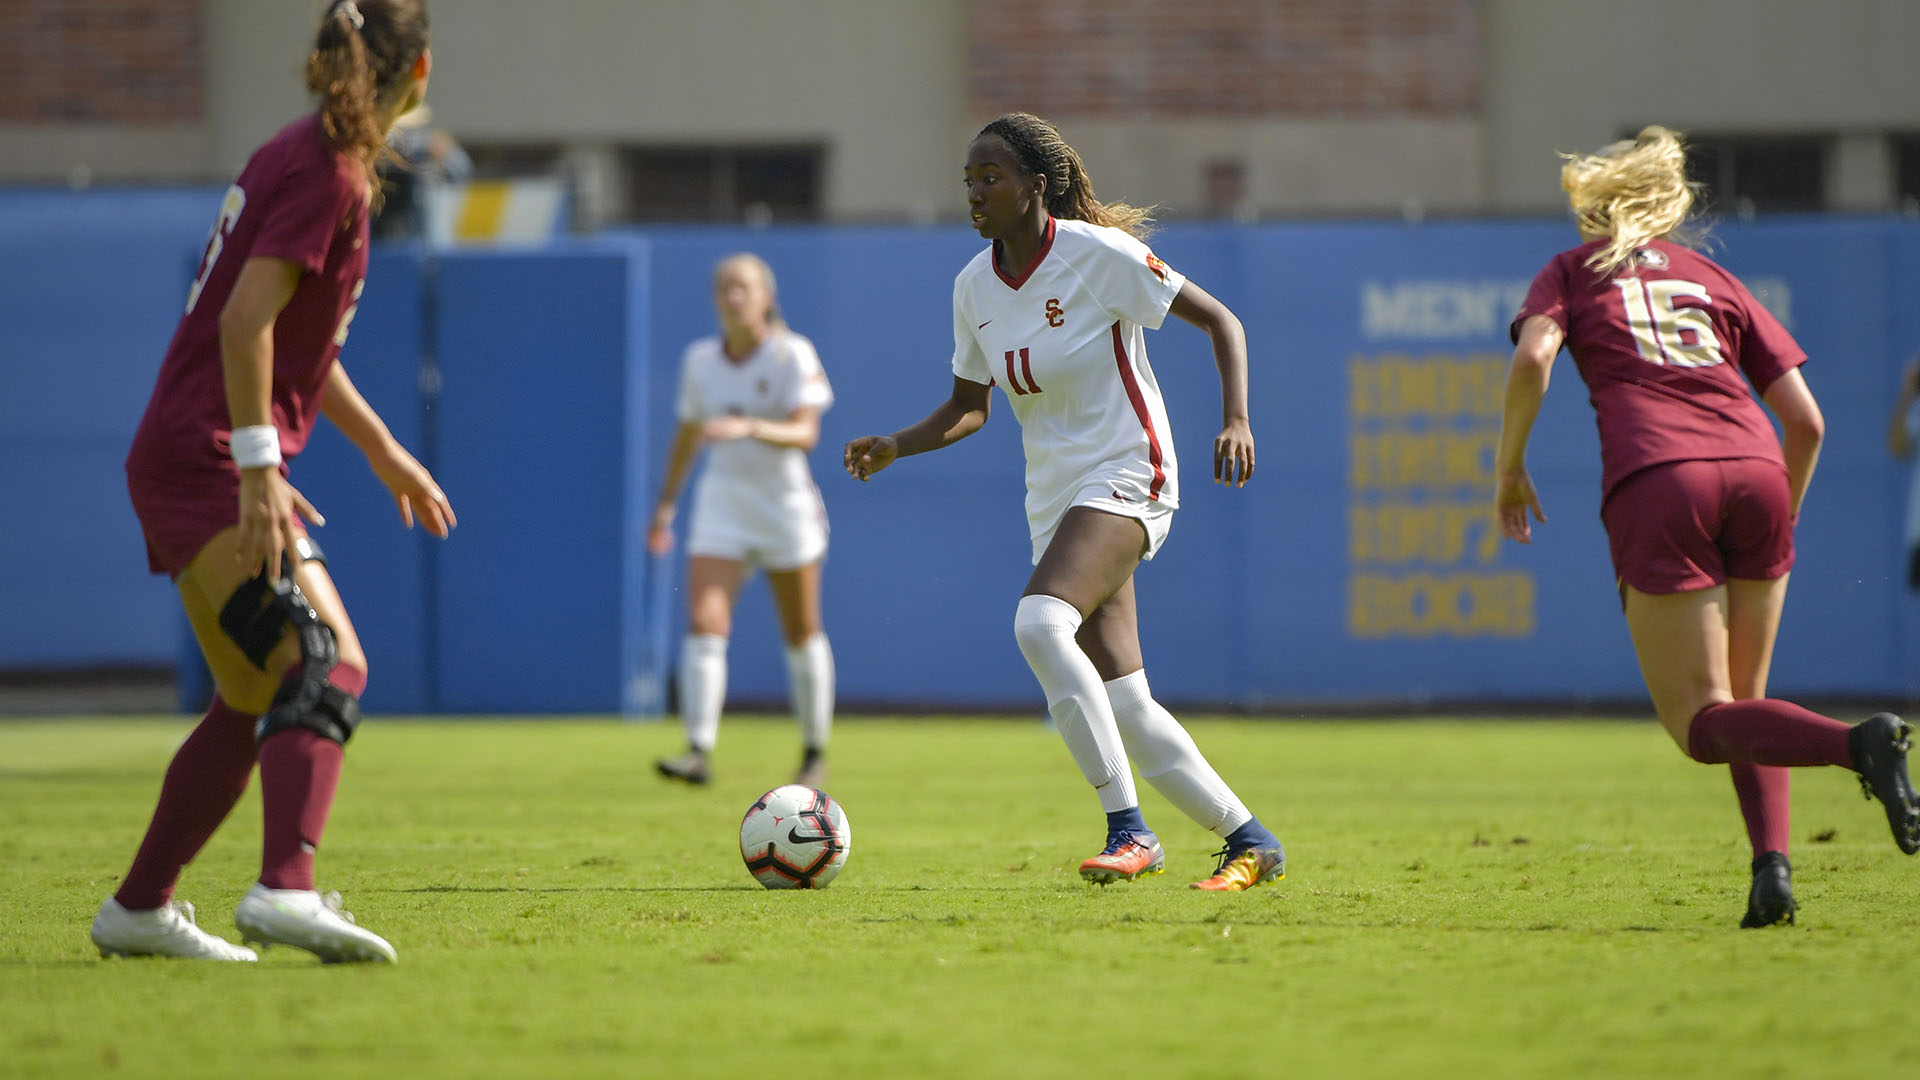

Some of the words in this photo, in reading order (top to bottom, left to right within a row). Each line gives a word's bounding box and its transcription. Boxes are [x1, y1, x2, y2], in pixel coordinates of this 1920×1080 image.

[1045, 298, 1064, 327] SC
[1612, 276, 1724, 368] 16
[1004, 347, 1043, 396] 11
